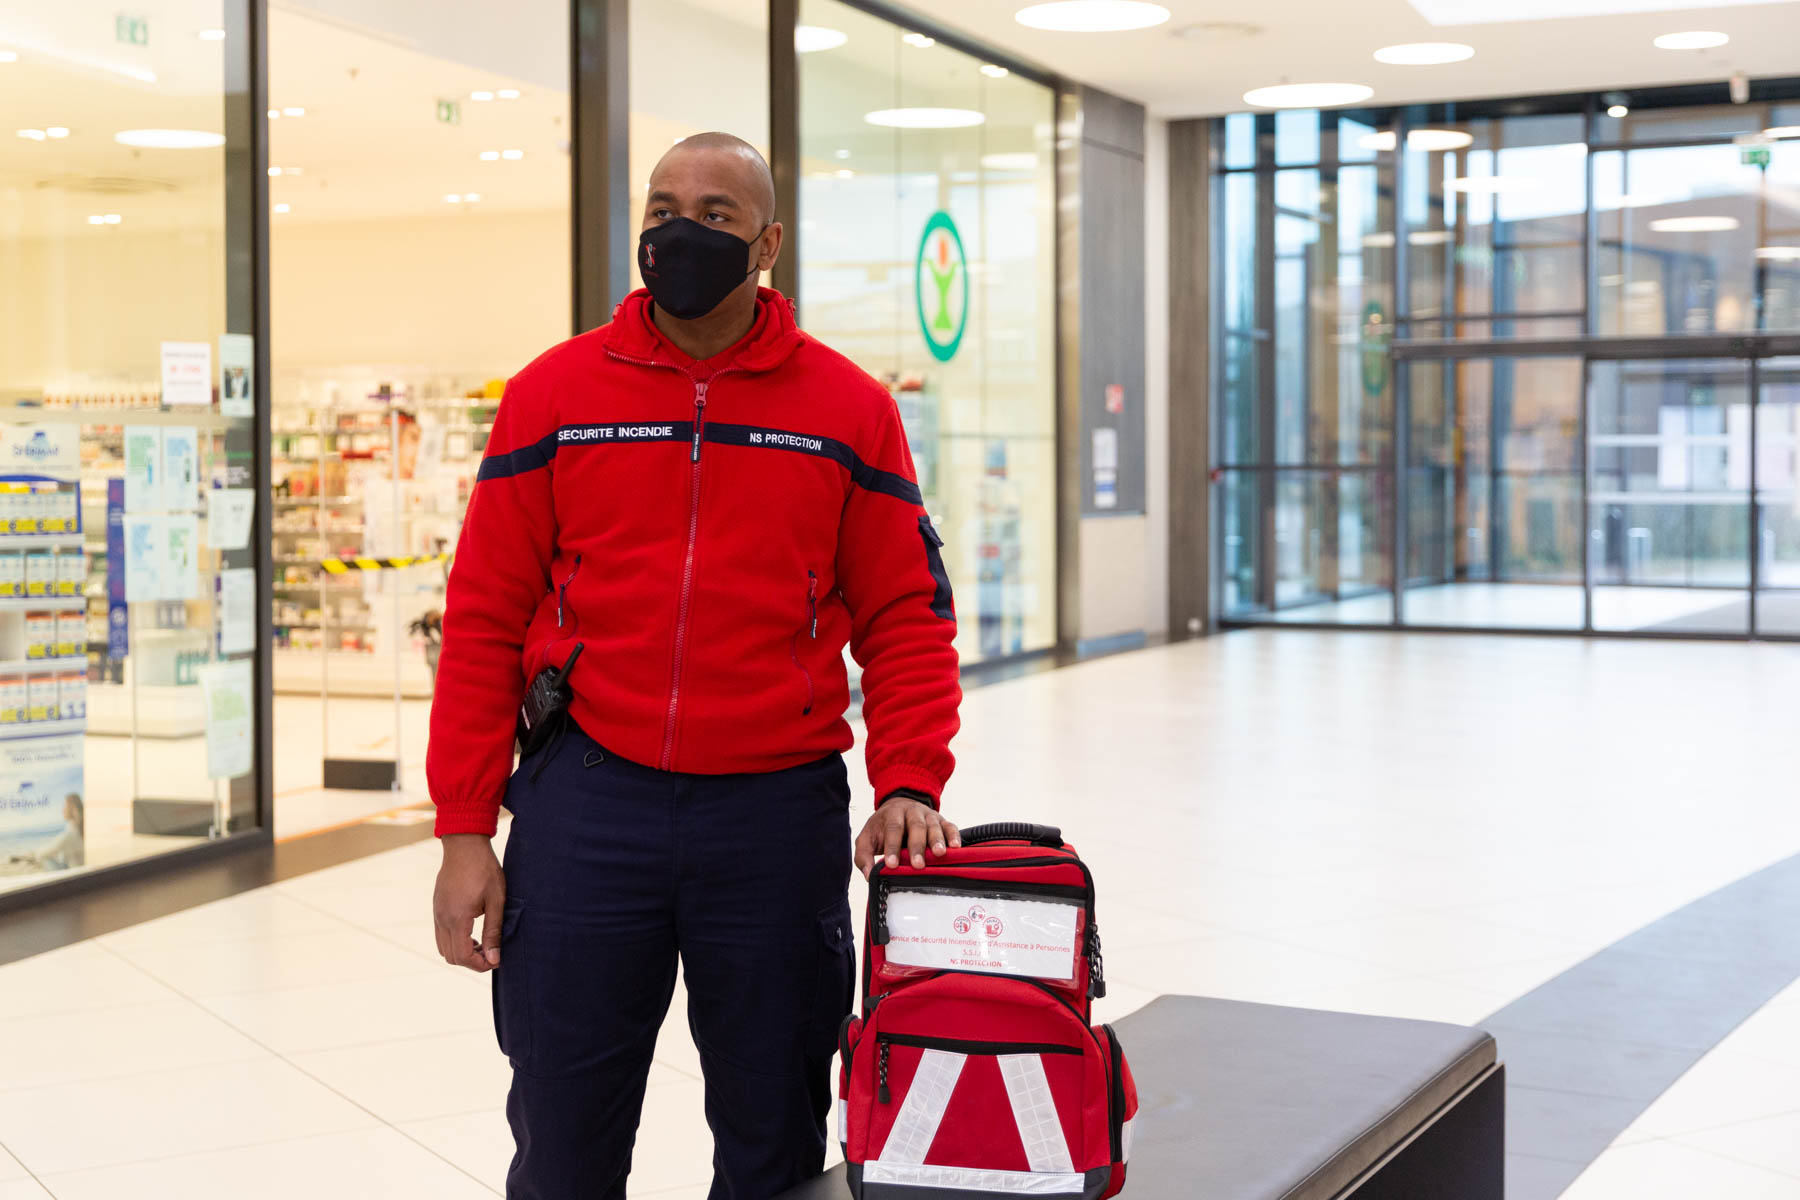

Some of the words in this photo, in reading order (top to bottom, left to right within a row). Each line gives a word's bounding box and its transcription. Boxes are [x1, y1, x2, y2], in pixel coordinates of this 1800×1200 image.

[558, 428, 614, 441] SECURITE
[618, 426, 673, 437] INCENDIE
[749, 432, 762, 443] NS
[765, 433, 822, 451] PROTECTION
[911, 935, 920, 943] de
[920, 936, 947, 945] Sécurité
[948, 937, 977, 947] Incendie
[1035, 943, 1071, 953] Personnes
